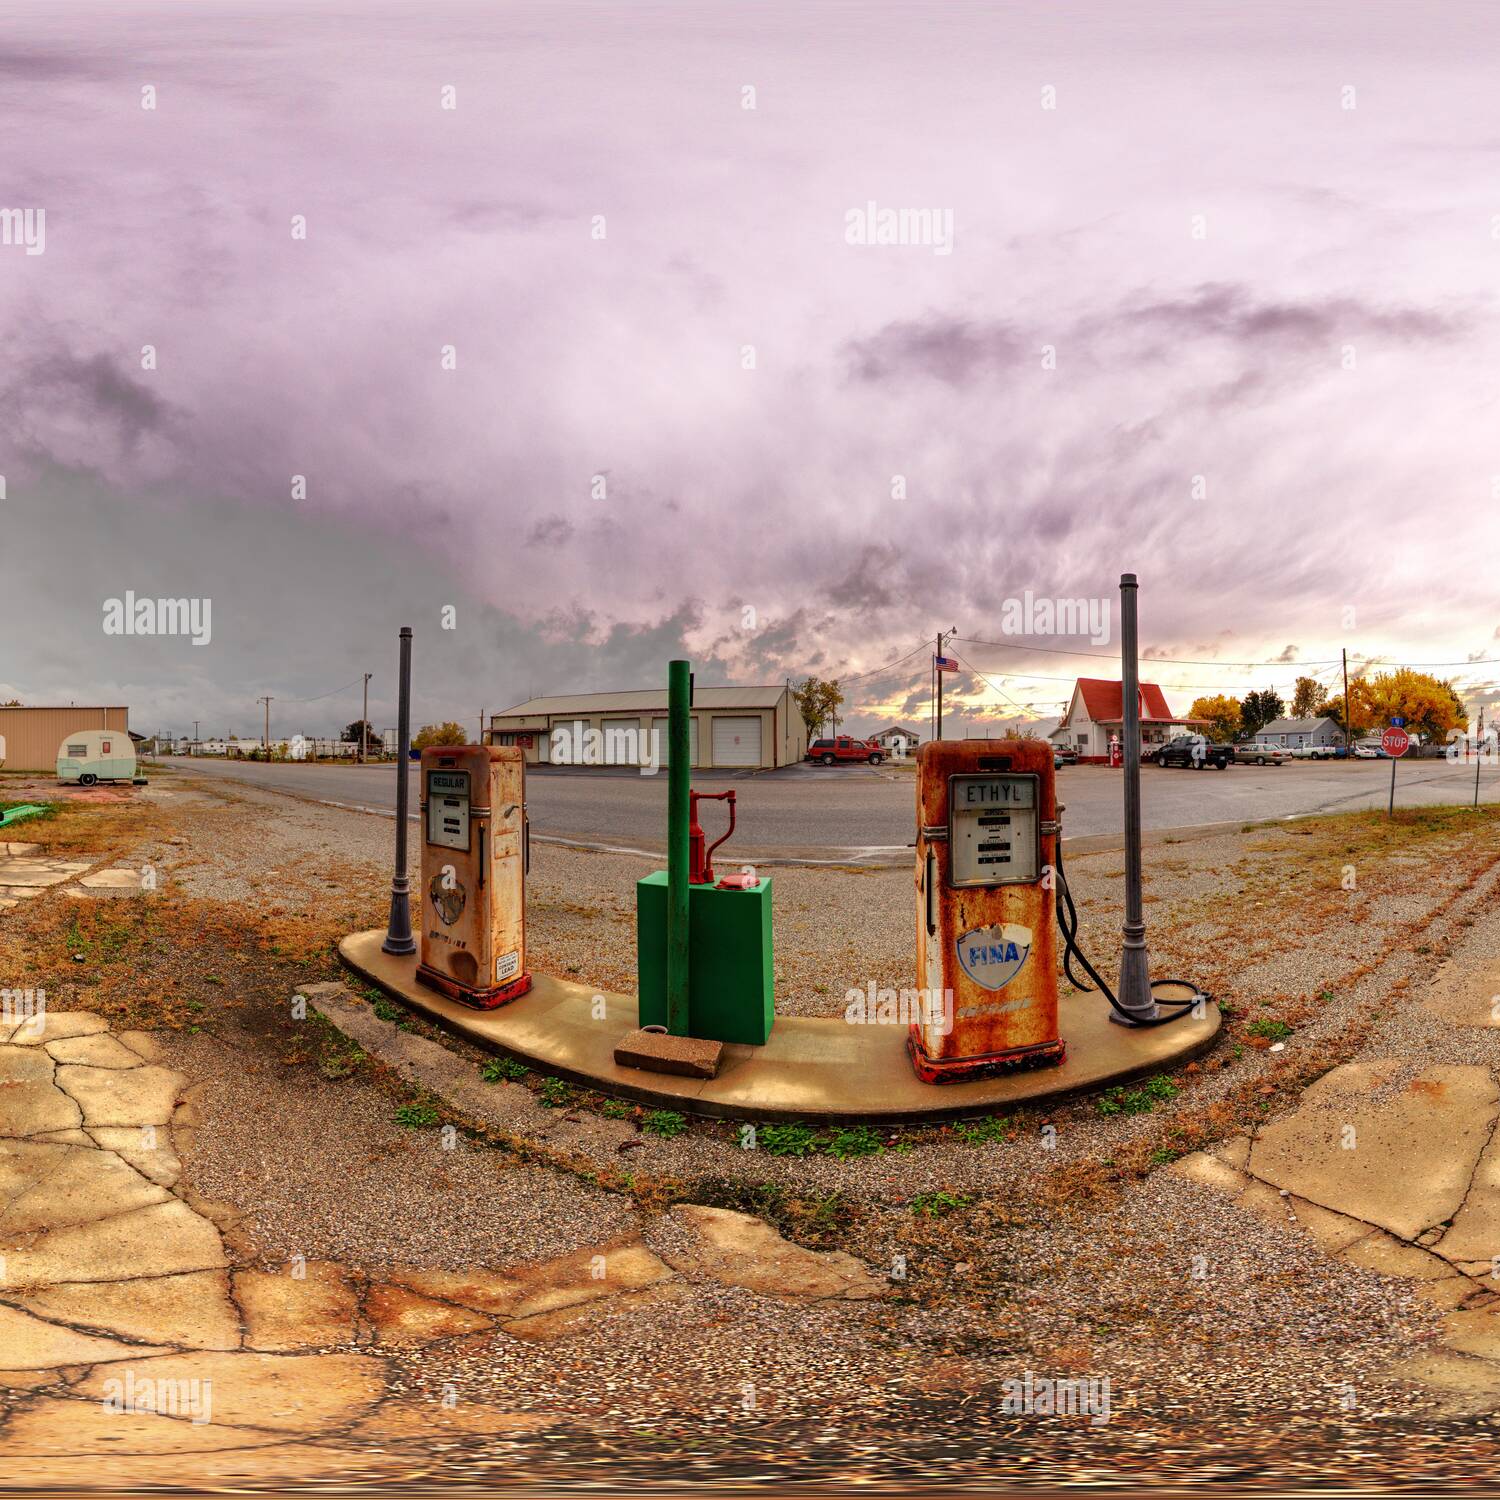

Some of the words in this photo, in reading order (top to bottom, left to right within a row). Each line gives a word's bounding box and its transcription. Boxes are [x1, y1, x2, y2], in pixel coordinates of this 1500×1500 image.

[1383, 735, 1407, 748] STOP
[433, 776, 465, 789] REGULAR
[967, 785, 1021, 802] ETHYL
[970, 943, 1020, 967] FINA
